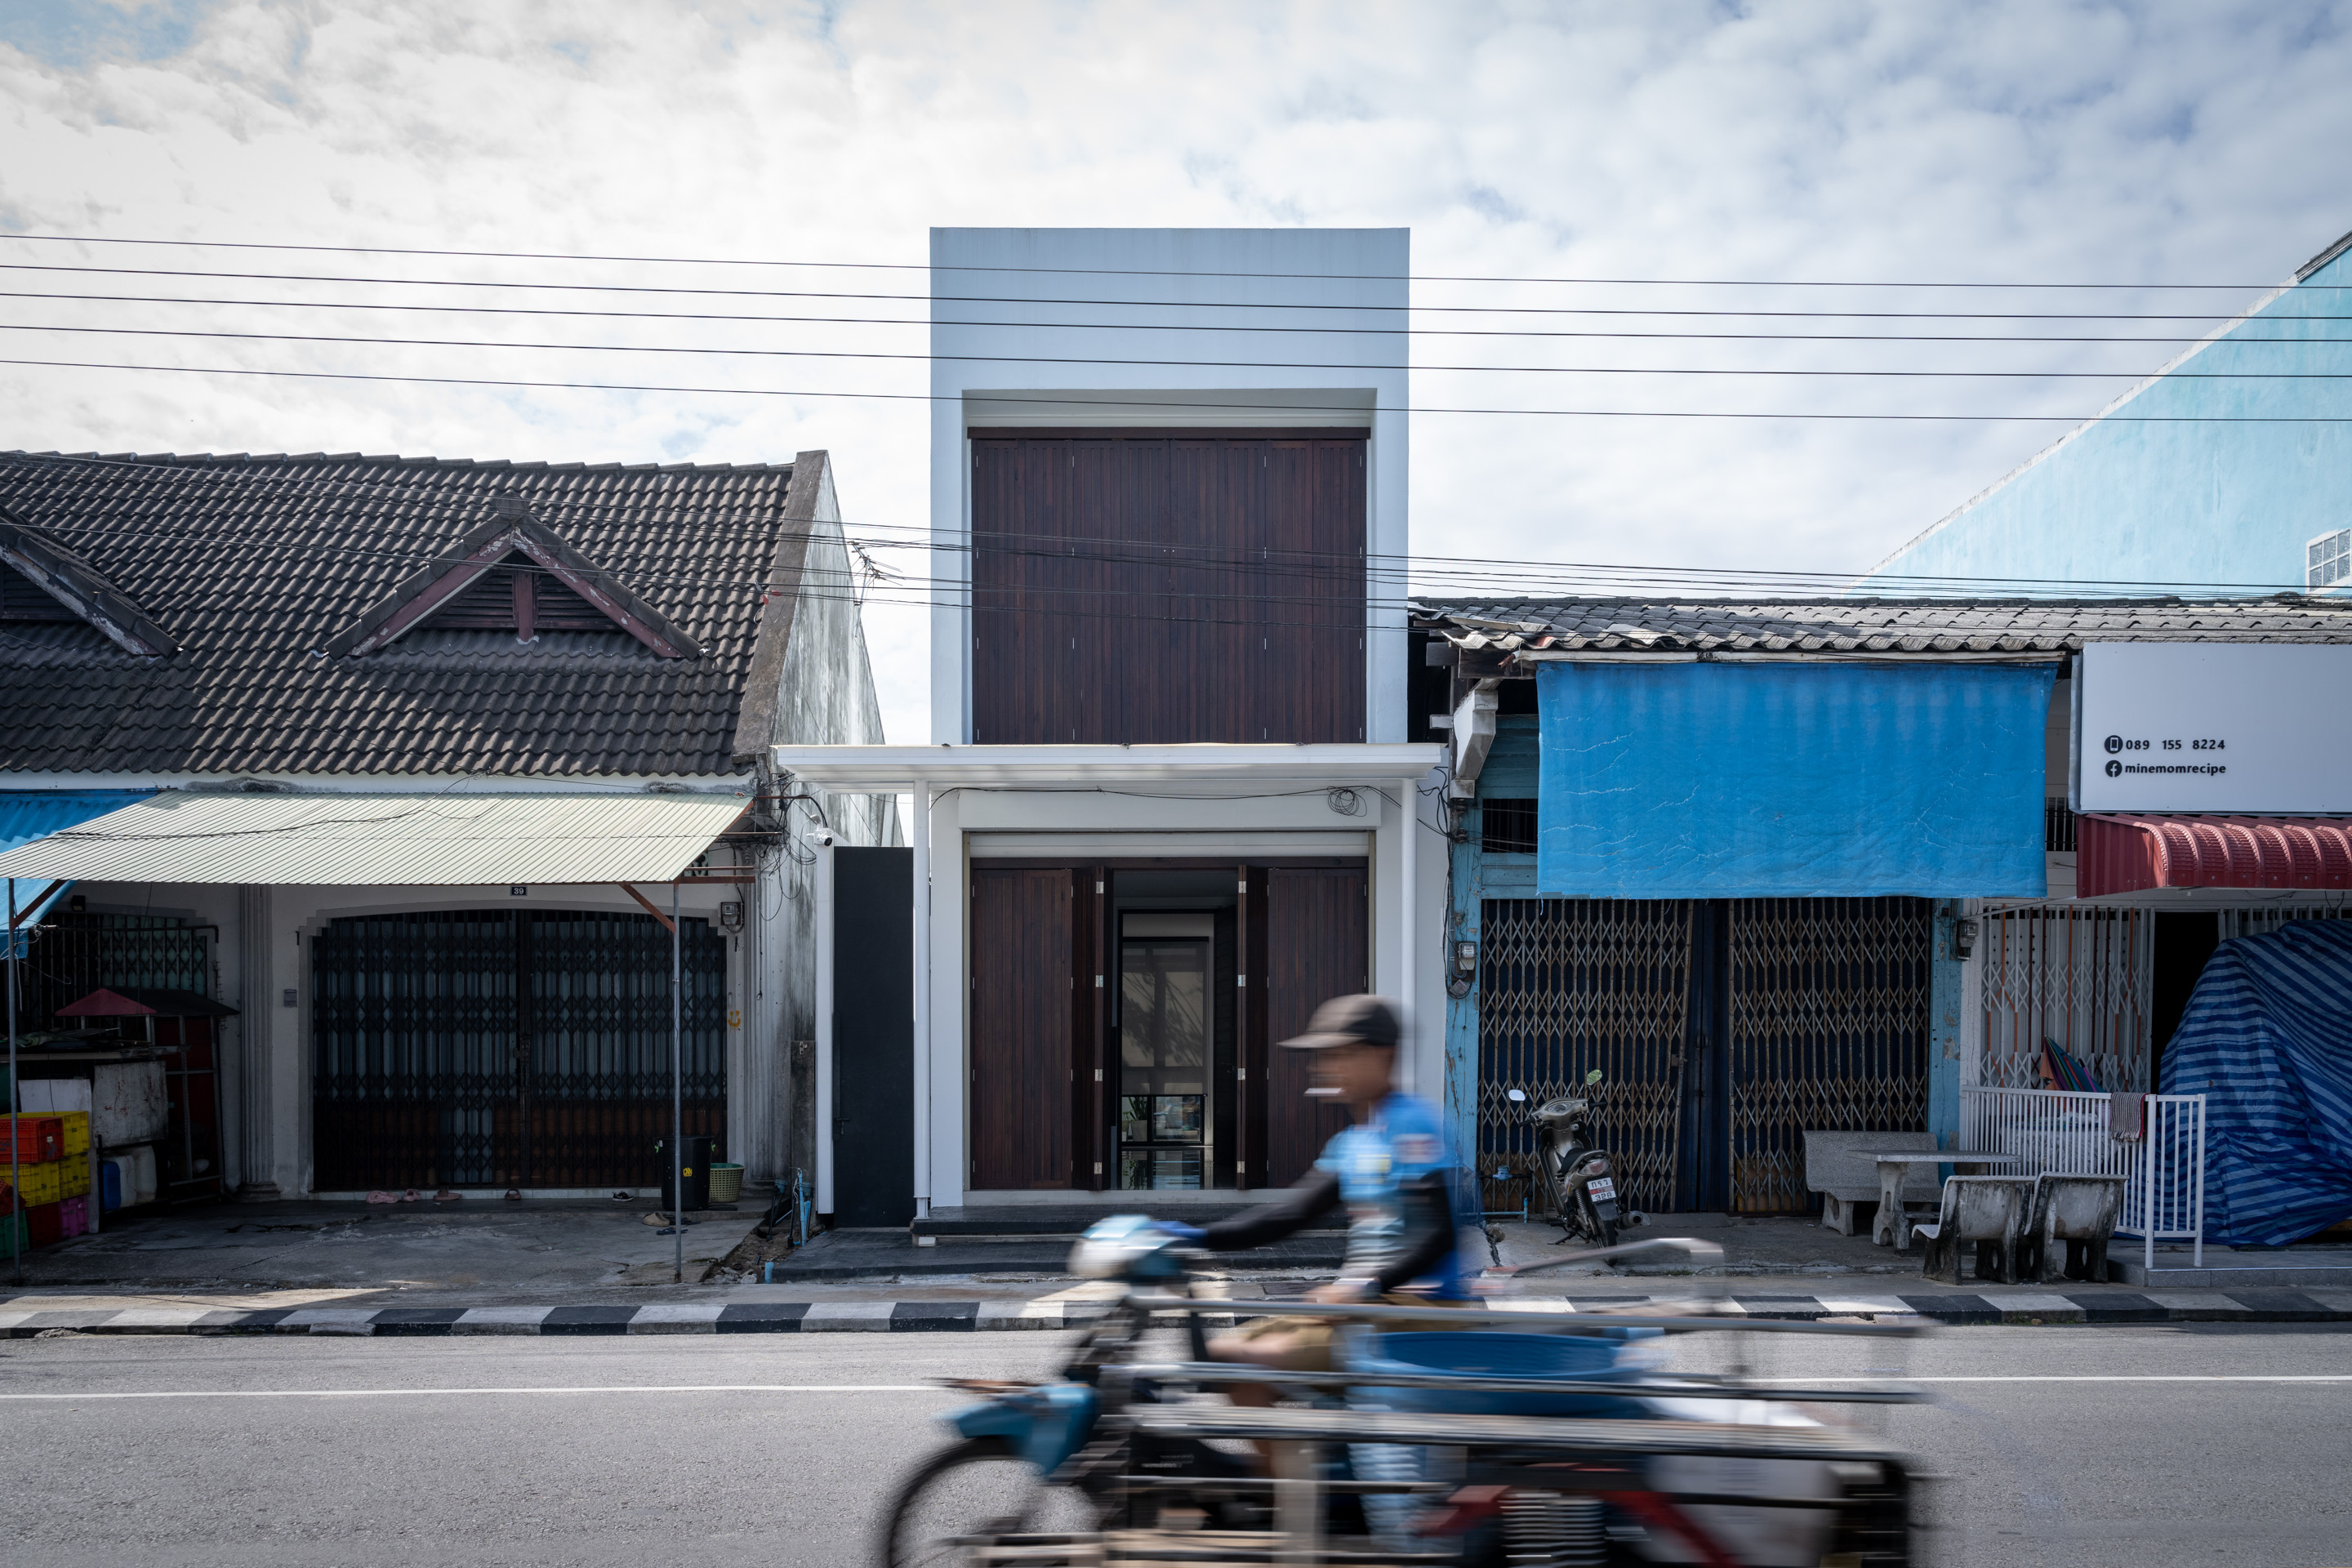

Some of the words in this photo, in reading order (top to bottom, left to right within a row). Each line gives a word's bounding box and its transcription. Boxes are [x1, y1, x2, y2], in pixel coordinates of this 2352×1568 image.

[2126, 740, 2149, 750] 089
[2162, 740, 2182, 750] 155
[2192, 739, 2225, 750] 8224
[2125, 763, 2226, 776] minemomrecipe
